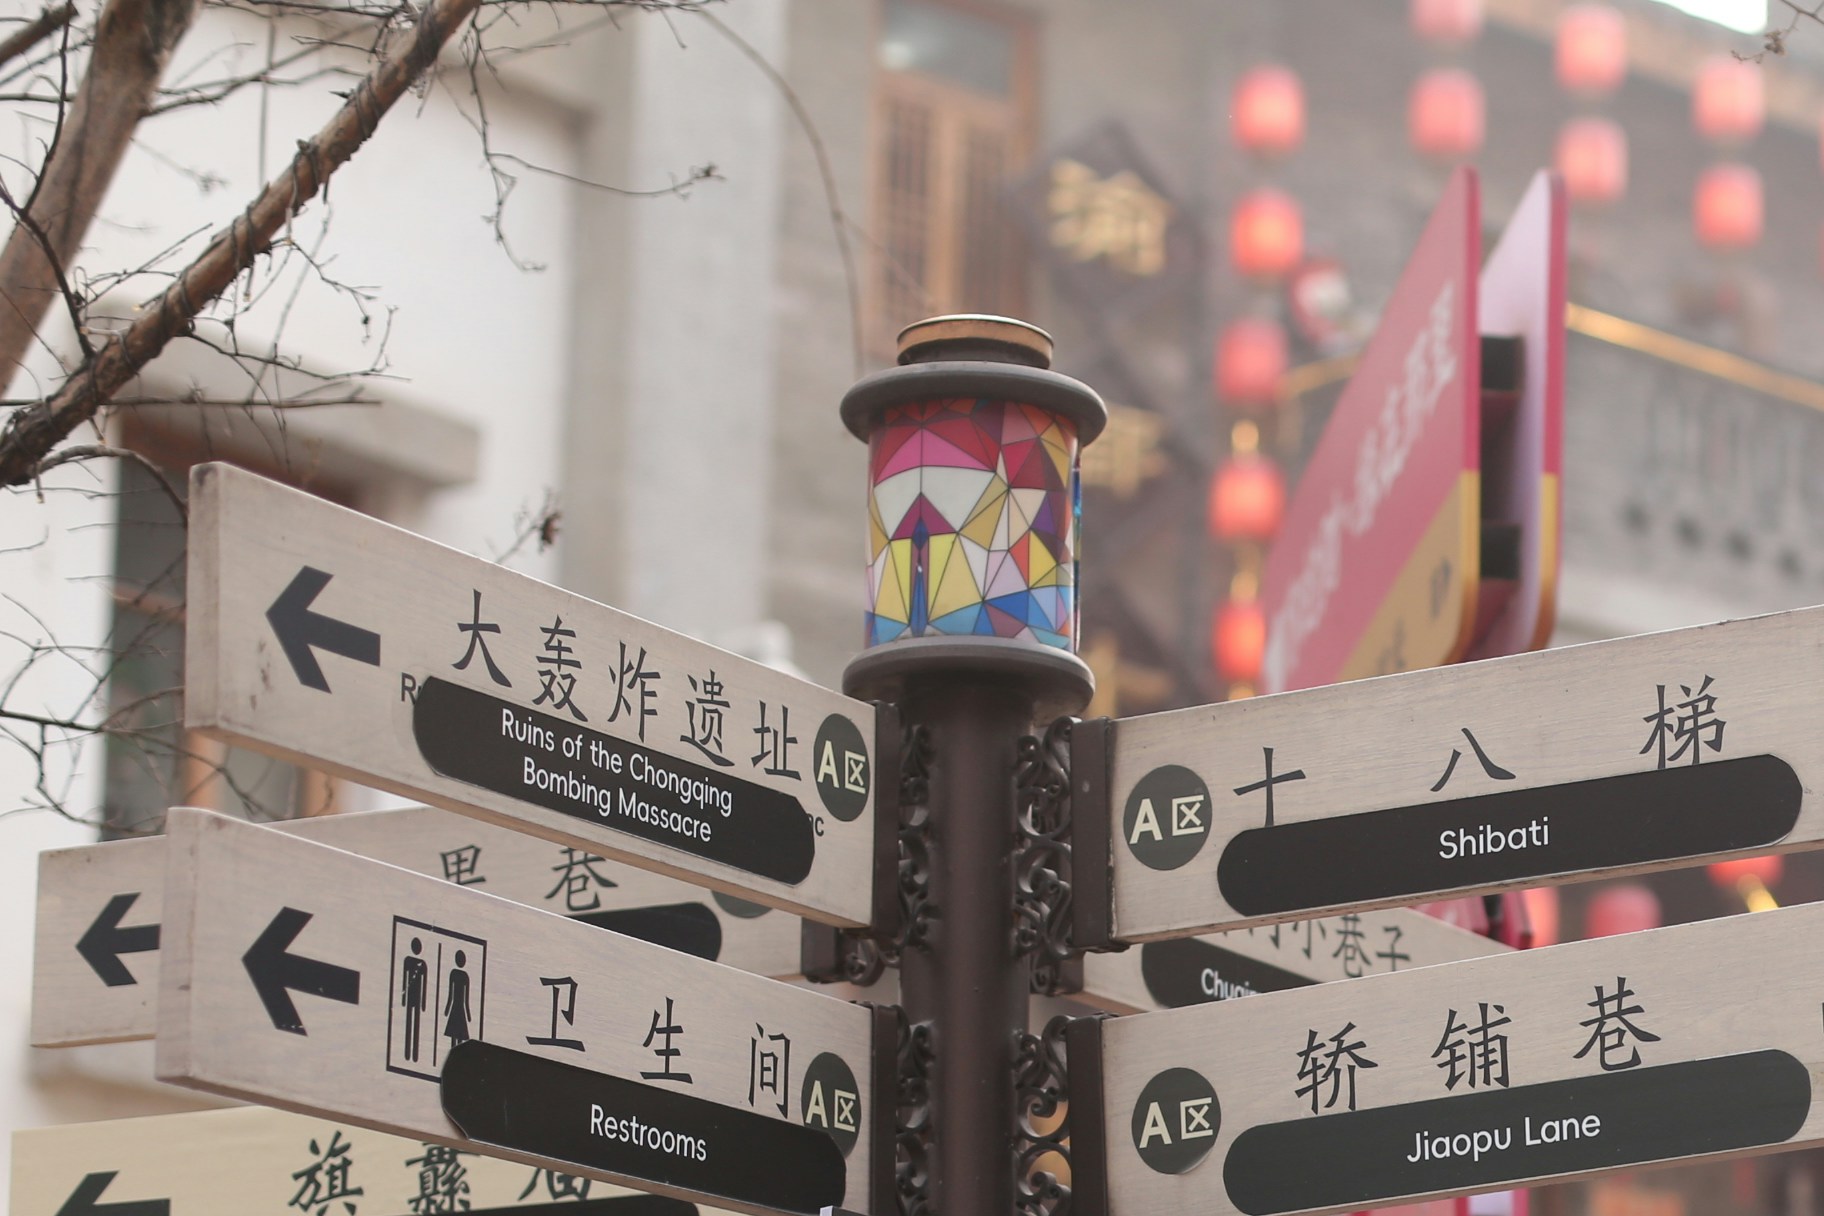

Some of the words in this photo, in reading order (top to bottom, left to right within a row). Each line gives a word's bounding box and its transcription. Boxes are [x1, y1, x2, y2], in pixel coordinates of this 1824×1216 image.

[452, 588, 801, 781] 大轰炸遗址
[502, 708, 554, 752] Ruins
[563, 733, 583, 759] of
[590, 739, 623, 773] the
[630, 754, 733, 817] Chongqing
[523, 757, 611, 818] Bombing
[618, 792, 712, 842] Massacre
[1233, 675, 1726, 827] 十八梯
[1438, 816, 1550, 860] Shibati
[525, 976, 791, 1119] 卫生间
[1296, 975, 1662, 1116] 轿铺巷
[590, 1103, 707, 1161] Restrooms
[1406, 1121, 1512, 1164] Jiaopu
[1525, 1112, 1601, 1147] Lane
